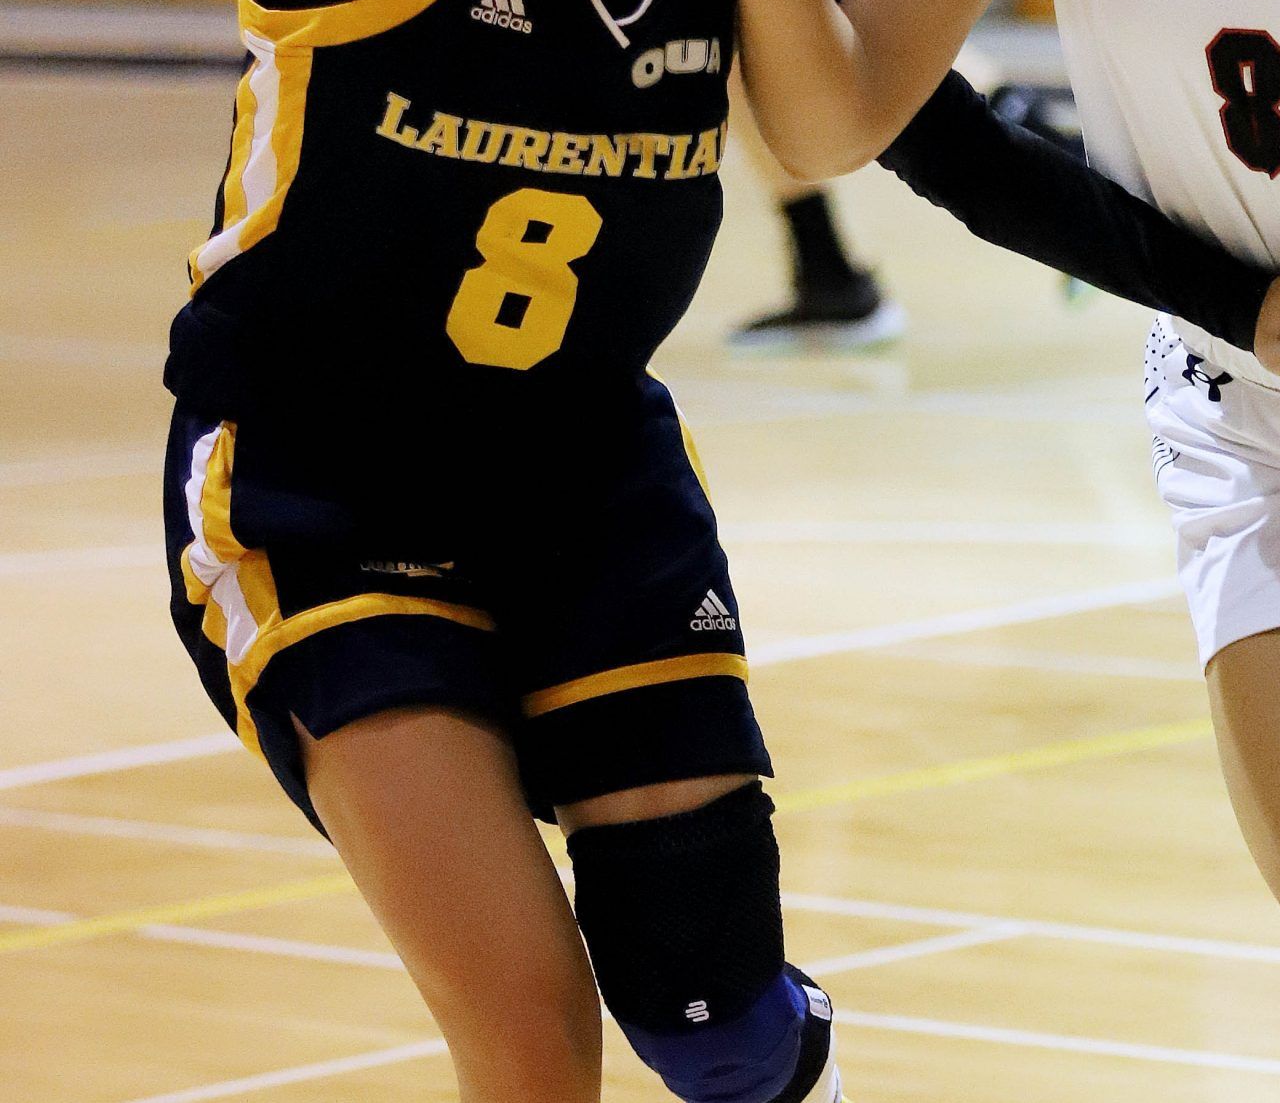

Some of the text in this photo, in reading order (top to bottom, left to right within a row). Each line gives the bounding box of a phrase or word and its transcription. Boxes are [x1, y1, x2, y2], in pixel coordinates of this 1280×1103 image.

[470, 6, 532, 34] adidas
[376, 91, 728, 180] LAURENTIA
[446, 188, 604, 370] 8
[690, 614, 737, 632] adidas
